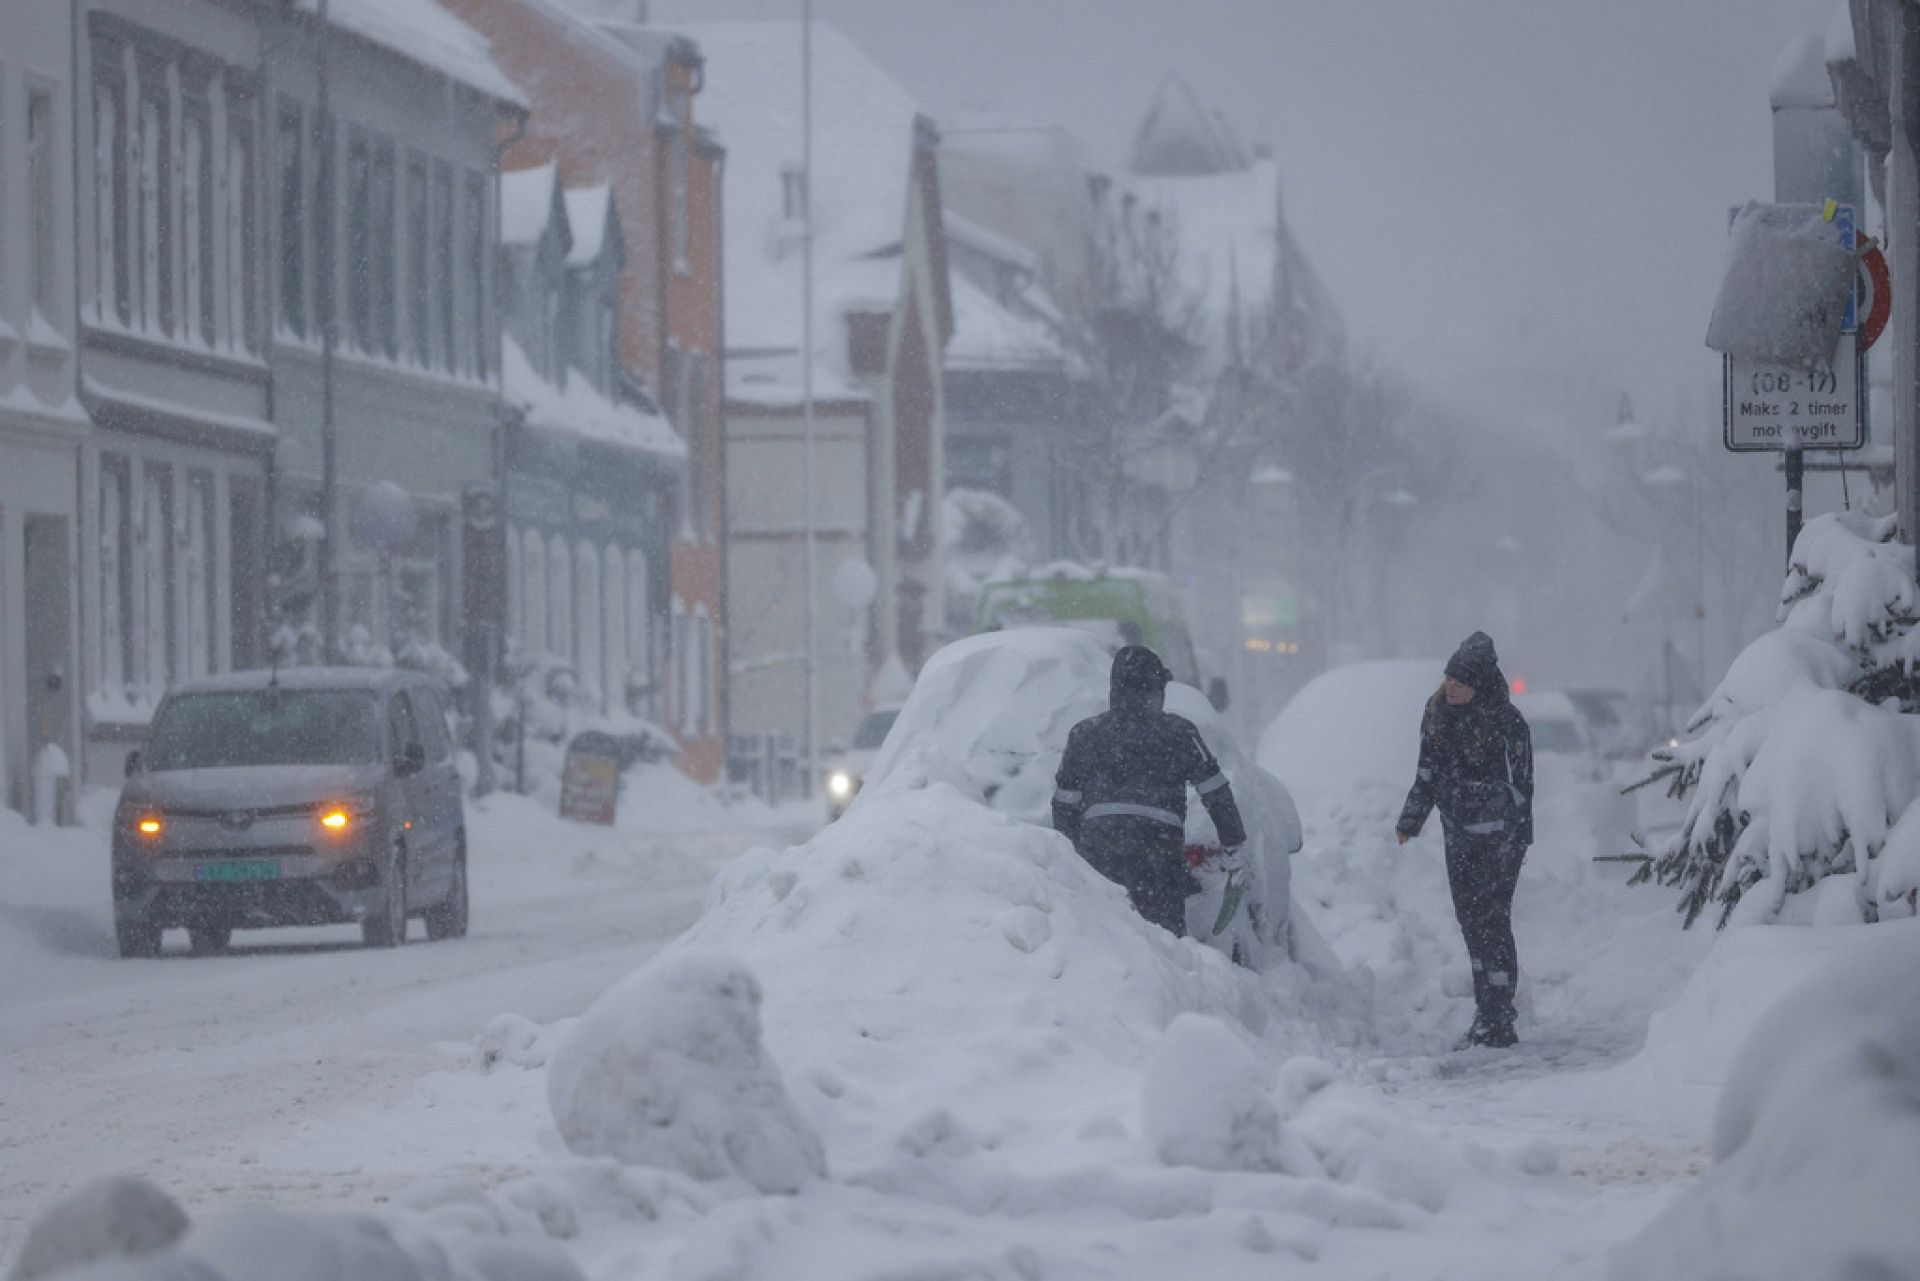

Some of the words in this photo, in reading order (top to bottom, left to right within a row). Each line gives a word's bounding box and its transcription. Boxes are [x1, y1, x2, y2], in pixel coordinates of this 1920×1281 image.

[1739, 402, 1780, 416] Maks
[1790, 401, 1799, 415] 2
[1808, 402, 1847, 415] timer
[1752, 425, 1782, 438] mot
